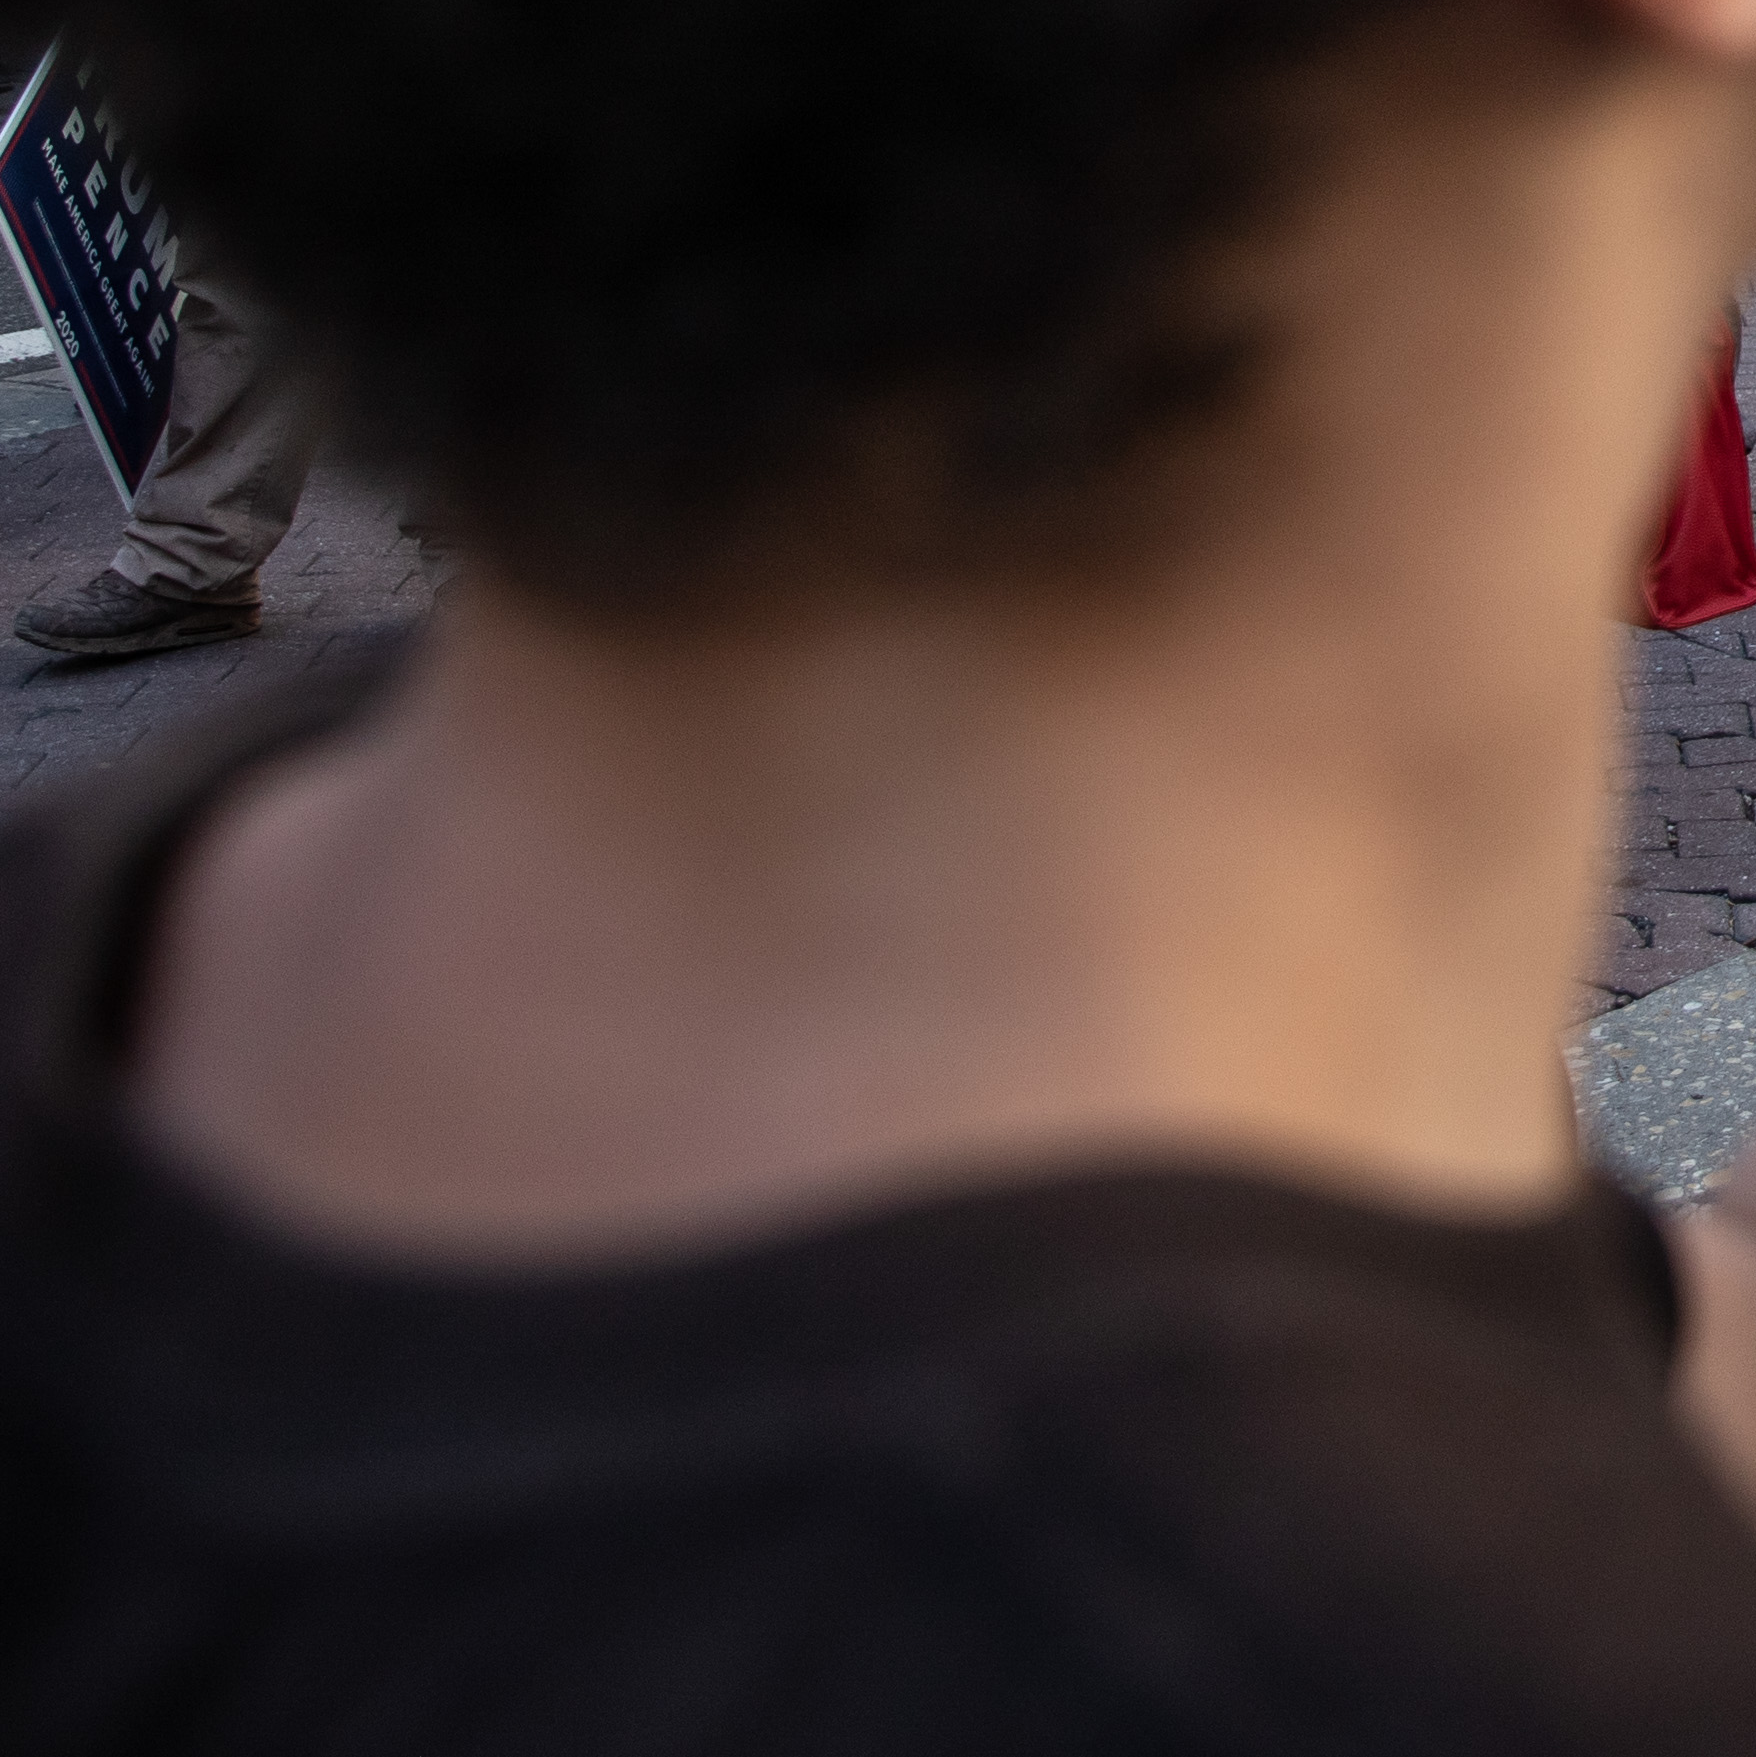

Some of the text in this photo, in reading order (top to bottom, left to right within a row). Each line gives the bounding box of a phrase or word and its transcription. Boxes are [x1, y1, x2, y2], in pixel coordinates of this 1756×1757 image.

[40, 136, 156, 400] MAKE AMERICA GREAT AGAIN!
[54, 309, 81, 359] 2020
[61, 105, 171, 361] PENCE
